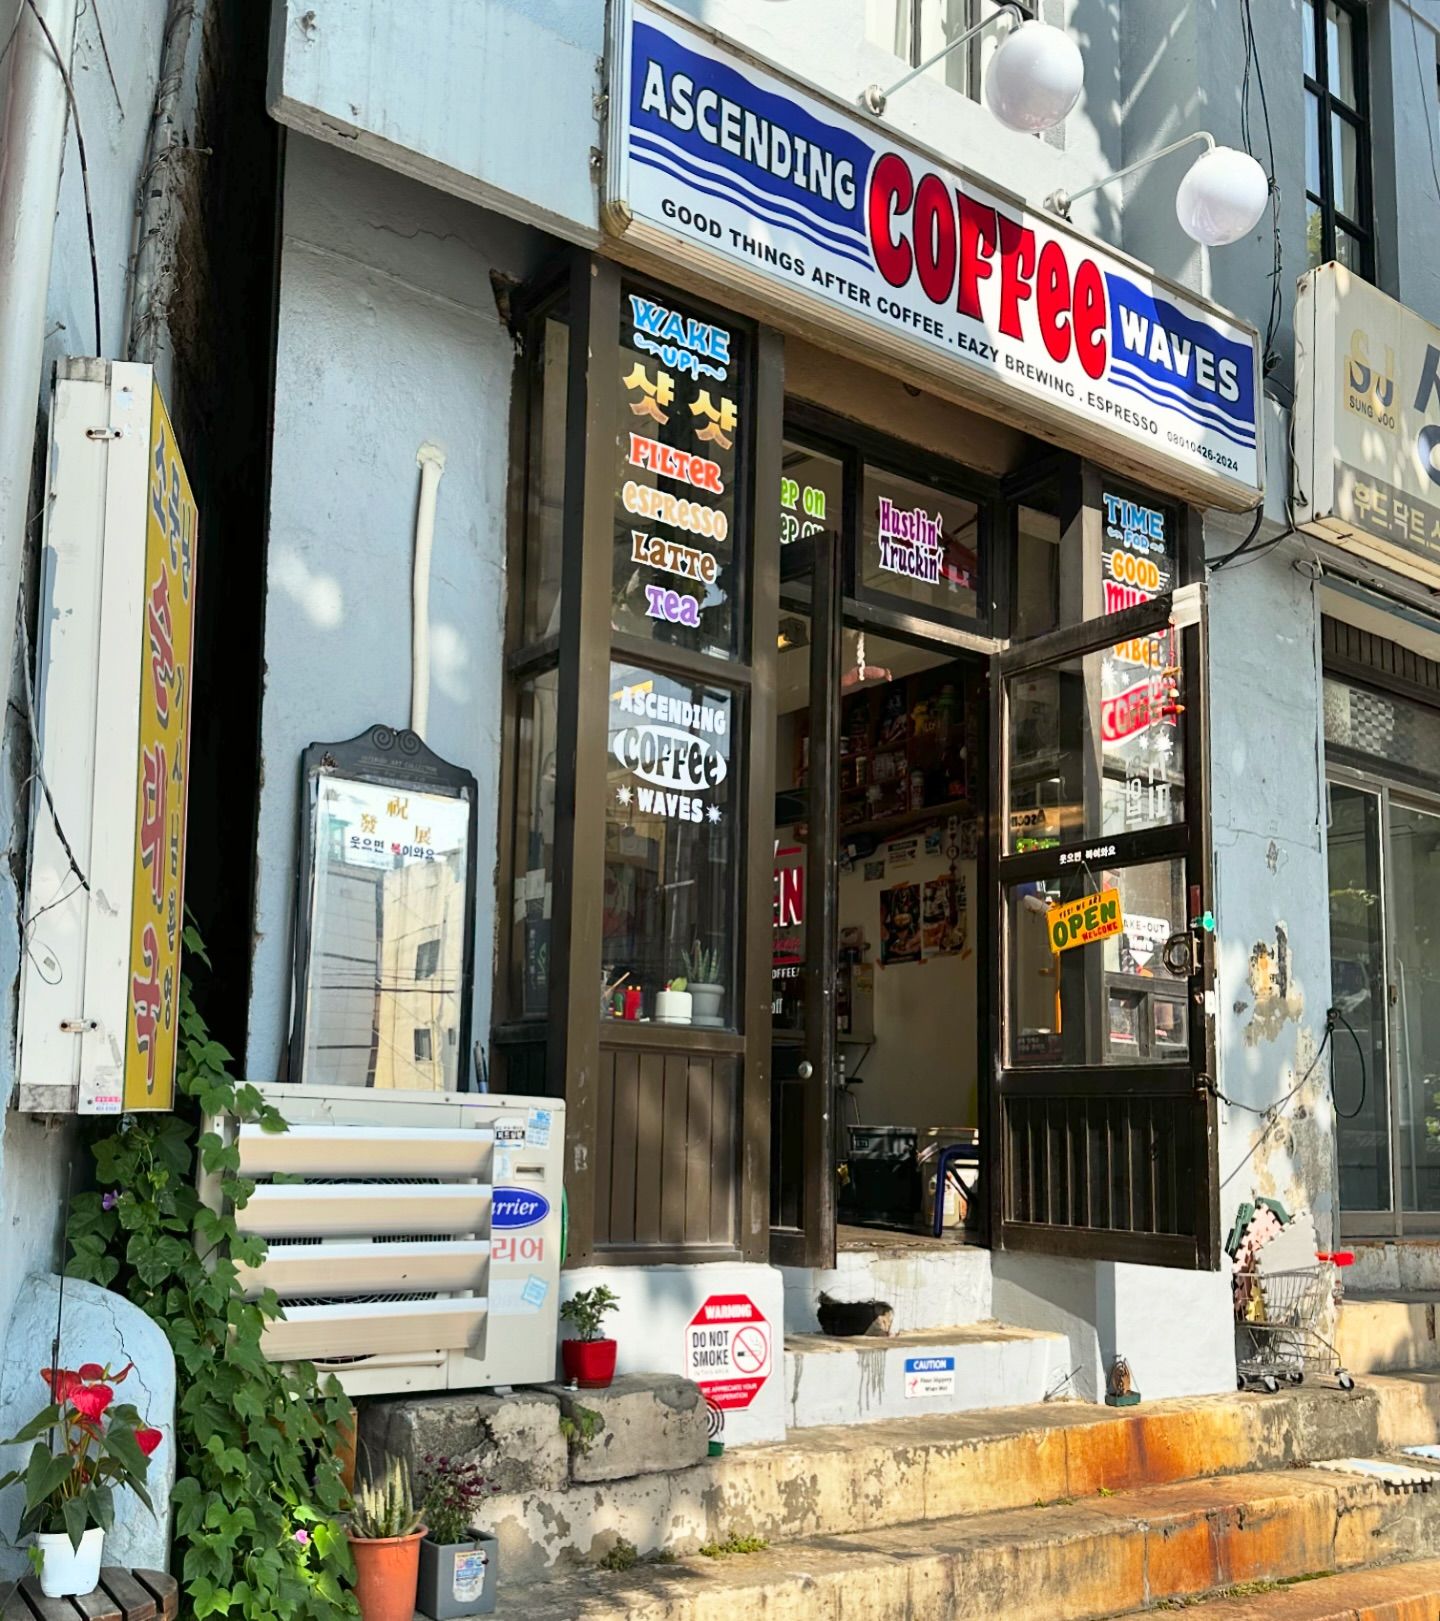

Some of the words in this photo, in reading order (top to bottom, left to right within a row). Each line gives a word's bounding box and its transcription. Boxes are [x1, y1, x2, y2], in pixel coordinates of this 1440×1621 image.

[641, 60, 857, 211] ASCENDING
[1118, 304, 1241, 404] WAVES
[629, 294, 730, 364] WAKE
[661, 198, 722, 239] GOOD
[729, 228, 805, 276] THINGS
[811, 267, 871, 307] AFTER
[877, 296, 944, 340] COFFEE
[957, 331, 998, 364] EAZY
[1005, 354, 1075, 398] BREWING
[1087, 391, 1159, 435] ESPRESSO
[622, 362, 675, 425] 샷
[688, 389, 738, 450] 샷
[1349, 395, 1374, 418] SUNG
[1377, 411, 1395, 430] JOO
[152, 420, 191, 605] 소문난
[878, 496, 943, 550] Hustlin'
[1103, 492, 1164, 541] TIME
[878, 535, 943, 584] Truckin'
[1124, 531, 1150, 554] FOR
[1110, 549, 1161, 590] GOOD
[619, 686, 726, 735] ASCENDING
[637, 787, 703, 823] WAVES
[350, 836, 384, 854] 웃으면
[1053, 900, 1116, 948] OPEN
[1081, 921, 1118, 942] WELCOME
[491, 1238, 544, 1262] 리어
[704, 1304, 752, 1319] WARNING
[692, 1332, 706, 1348] DO
[709, 1331, 728, 1346] NOT
[693, 1349, 728, 1367] SMOKE
[913, 1360, 947, 1370] CAUTION
